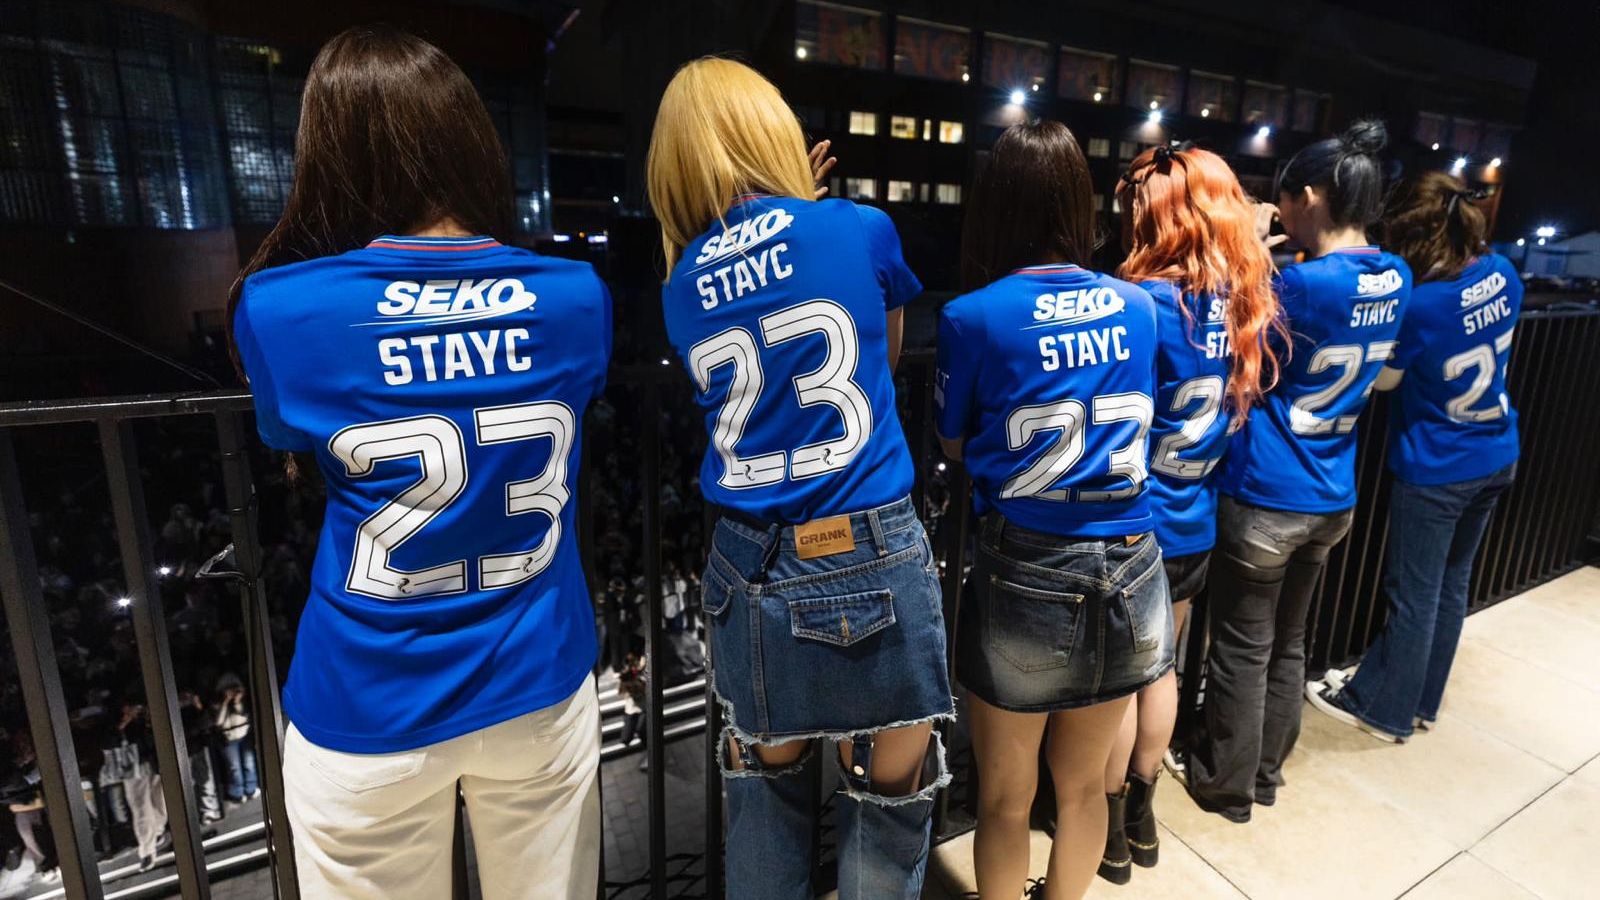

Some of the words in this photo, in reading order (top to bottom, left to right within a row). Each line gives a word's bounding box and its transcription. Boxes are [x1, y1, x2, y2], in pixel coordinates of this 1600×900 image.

[695, 208, 795, 266] SEKO
[376, 278, 537, 316] SEKO
[696, 242, 793, 311] STAYC
[1357, 268, 1403, 295] SEKO
[1460, 271, 1507, 308] SEKO
[1033, 287, 1126, 321] SEKO
[1350, 298, 1399, 328] STAYC
[1463, 295, 1511, 336] STAYC
[377, 327, 532, 386] STAYC
[1038, 325, 1130, 372] STAYC
[688, 298, 874, 491] 23
[999, 391, 1155, 503] 23
[328, 399, 575, 601] 23
[800, 528, 847, 546] CRANK
